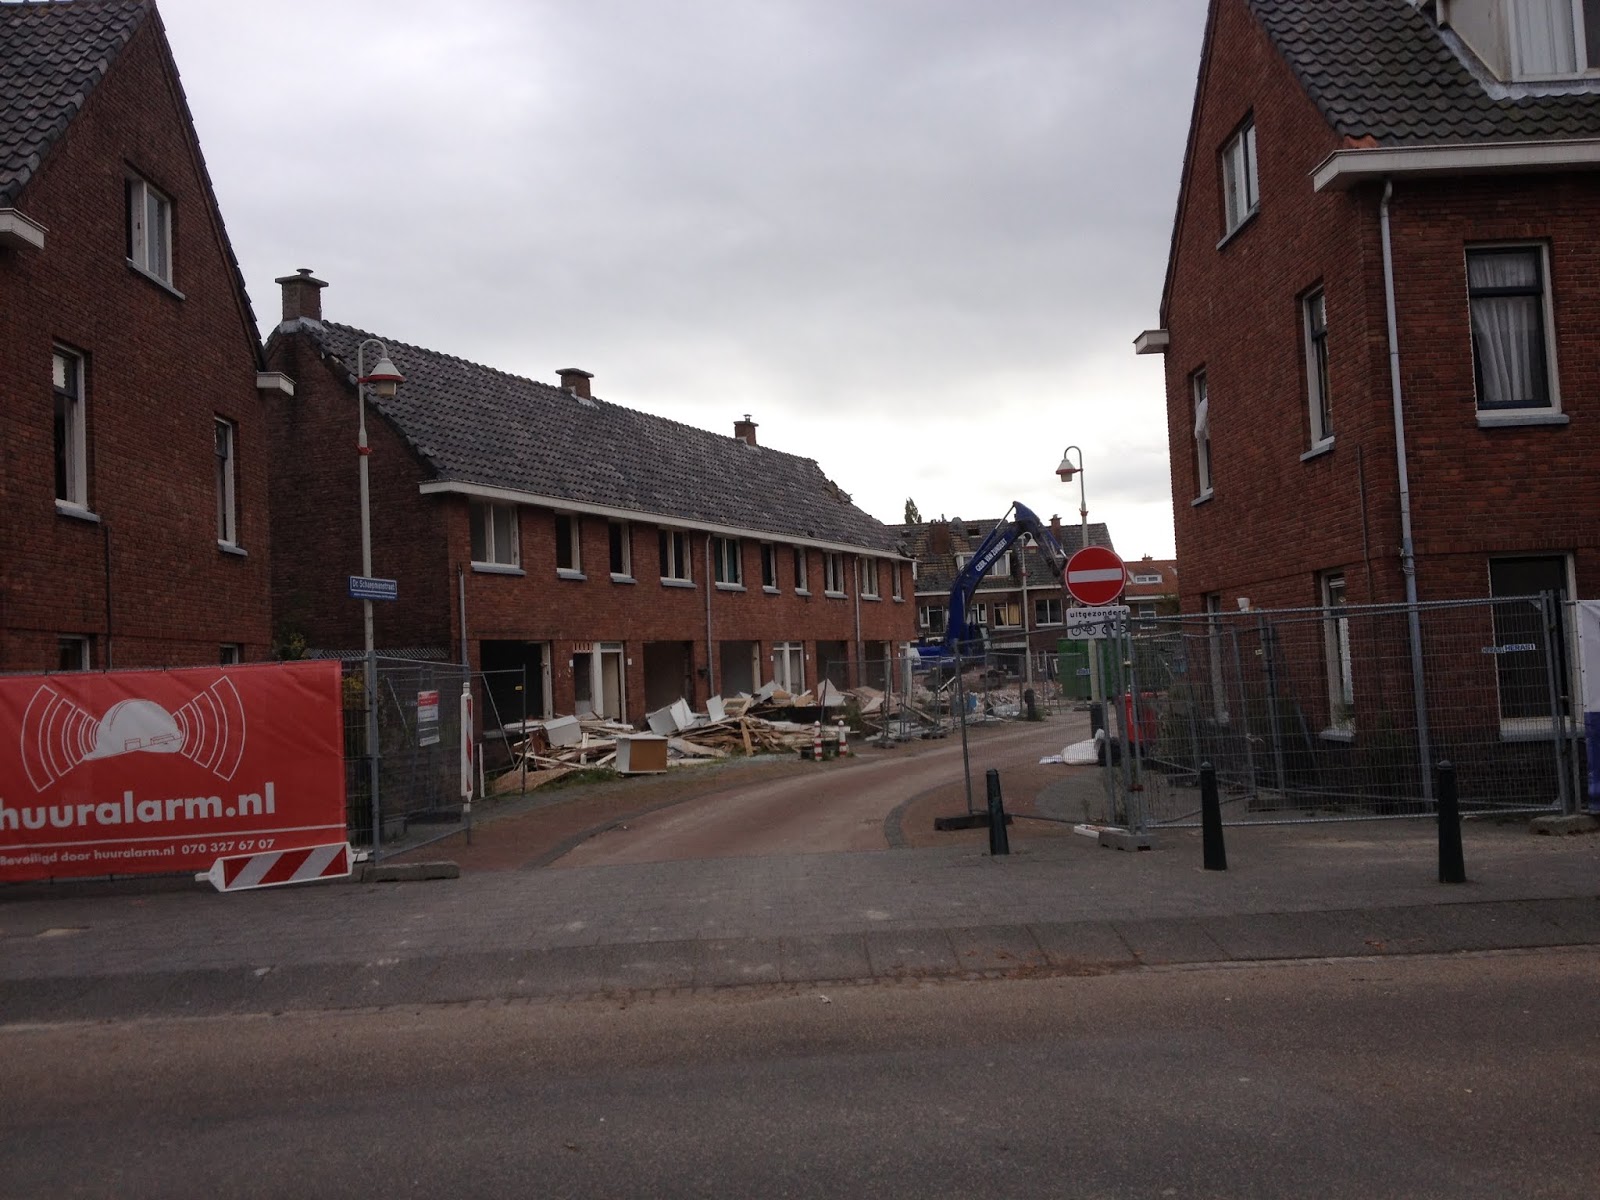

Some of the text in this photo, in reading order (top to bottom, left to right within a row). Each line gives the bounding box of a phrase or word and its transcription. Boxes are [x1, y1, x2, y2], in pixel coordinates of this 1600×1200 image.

[0, 781, 276, 830] huuralarm.nl
[61, 851, 91, 862] door
[94, 845, 175, 859] huuralarm.nl
[182, 843, 206, 855] 070
[211, 841, 235, 852] 327
[239, 840, 254, 850] 67
[258, 839, 275, 849] 07
